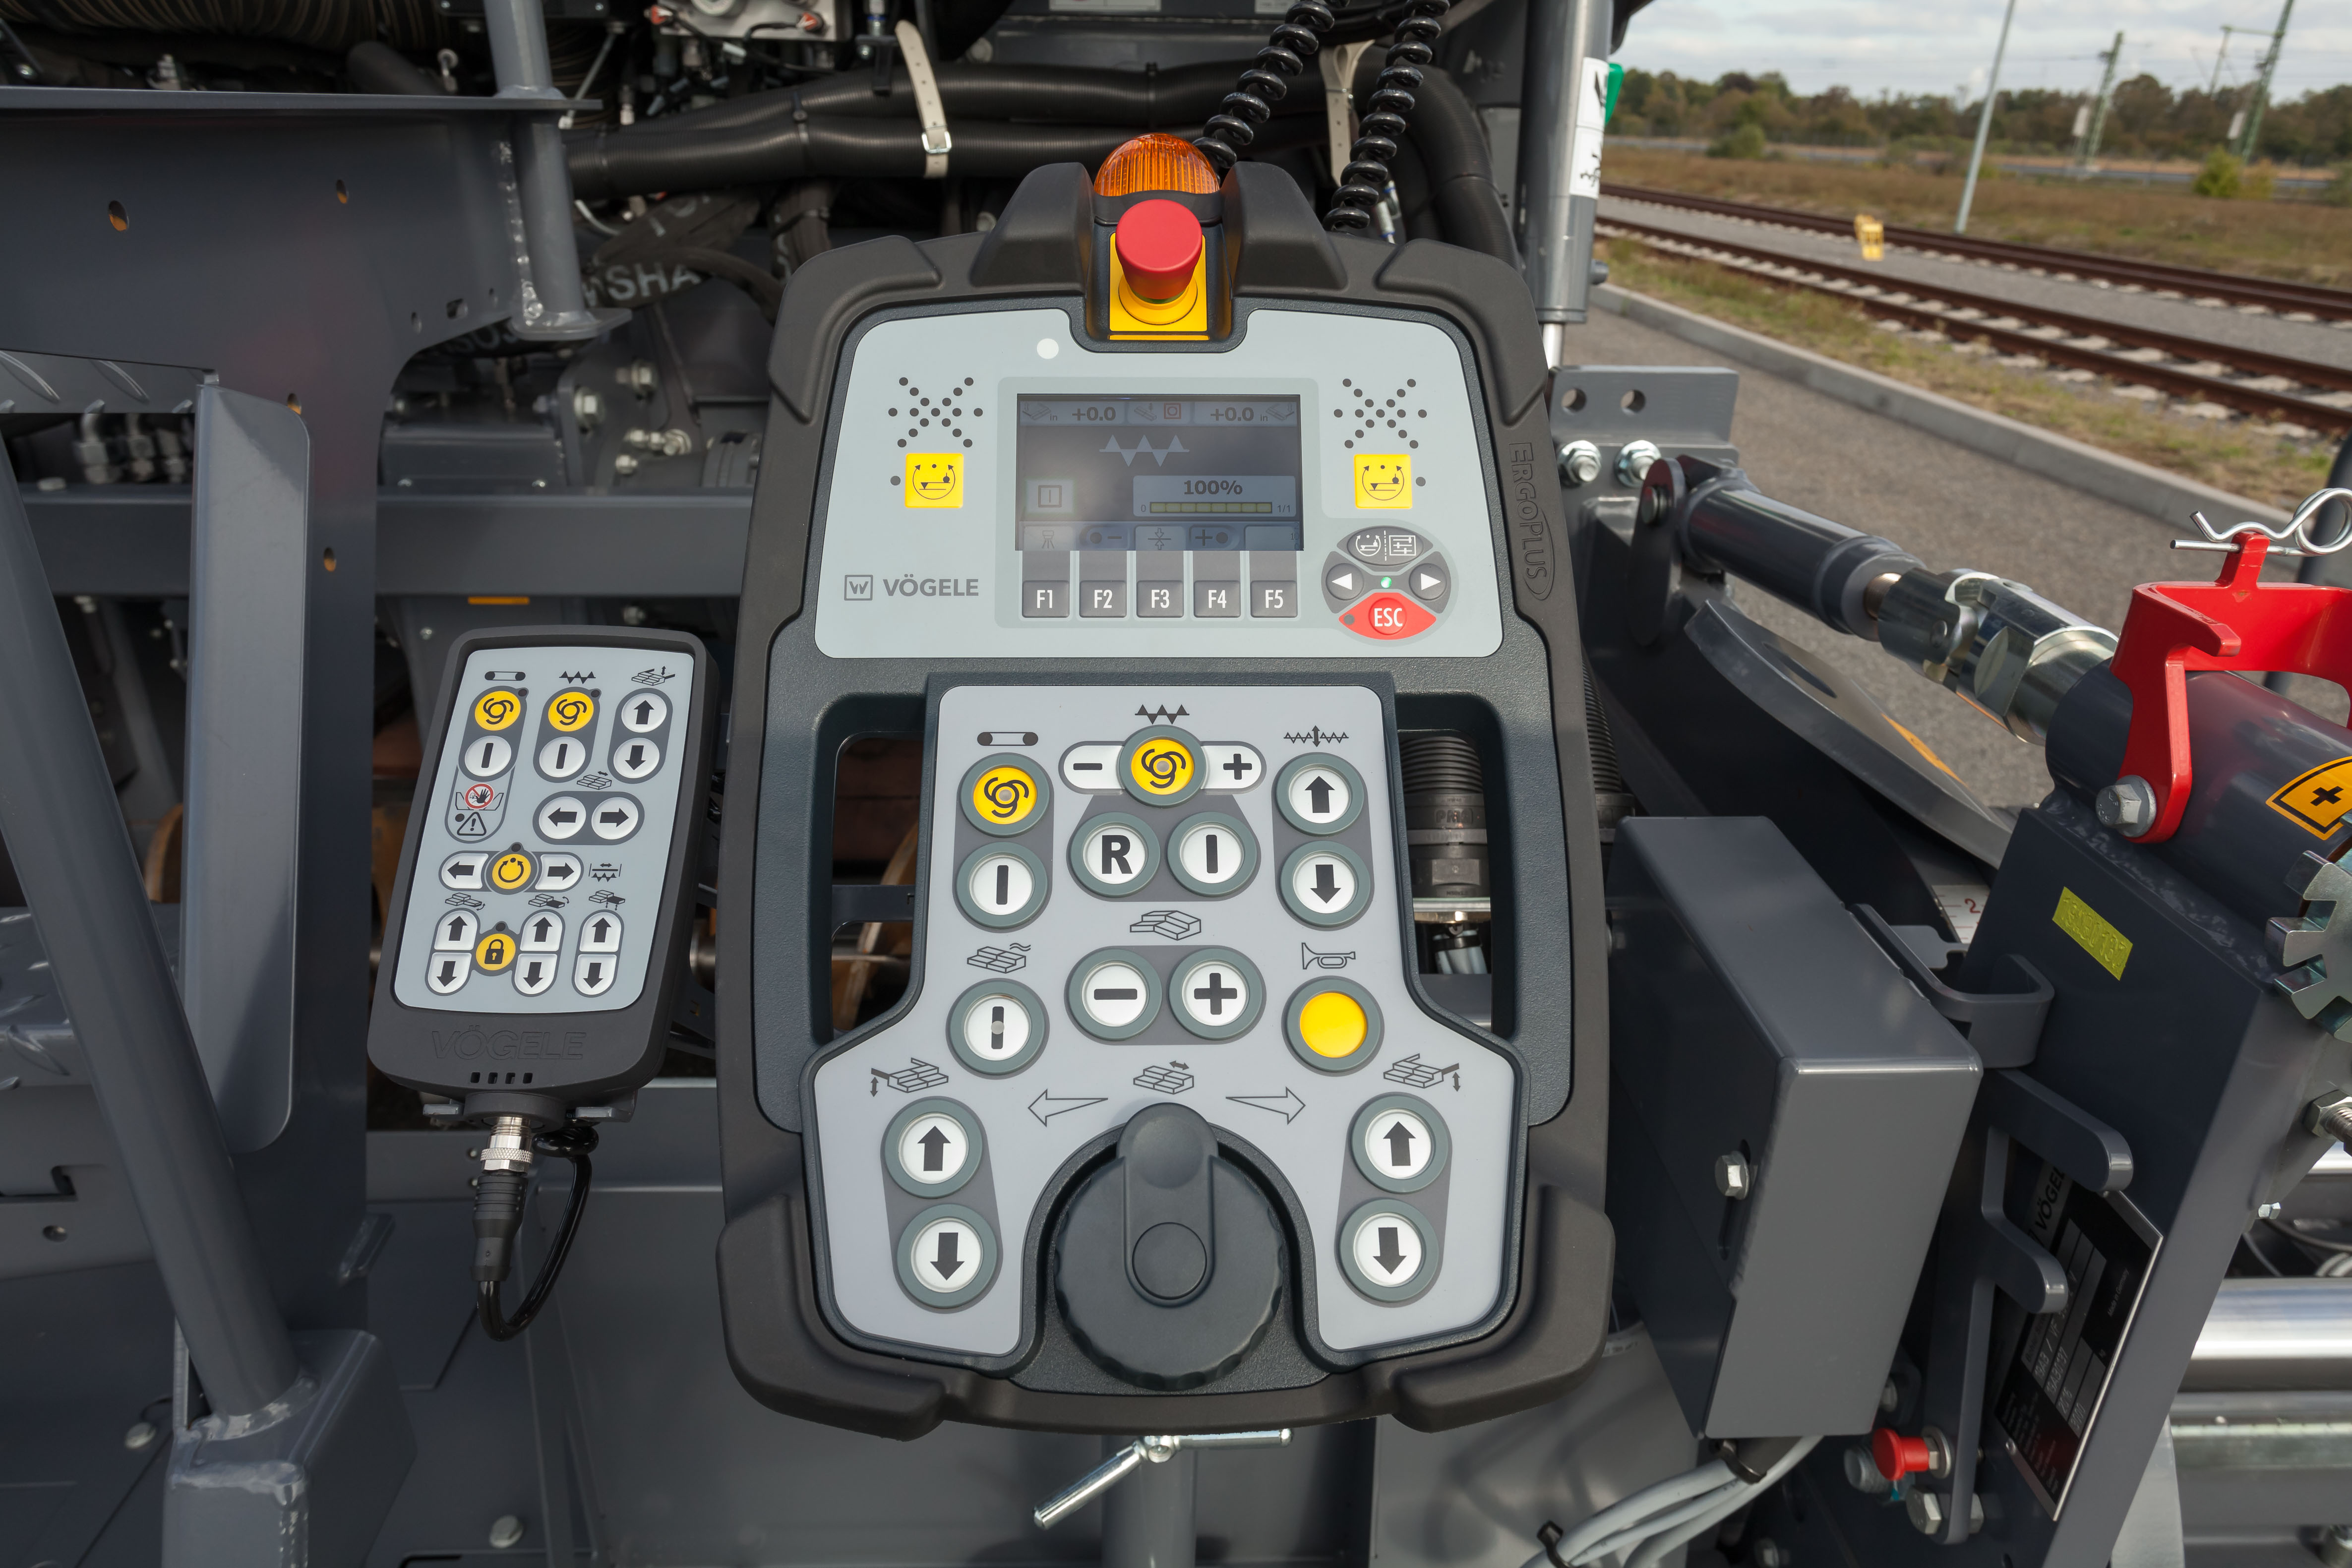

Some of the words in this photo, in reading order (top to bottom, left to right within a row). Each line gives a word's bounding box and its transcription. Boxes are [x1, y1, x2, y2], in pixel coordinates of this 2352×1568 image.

[1072, 406, 1116, 422] +0.0
[1210, 407, 1254, 422] +0.0
[1260, 414, 1268, 422] in
[1183, 480, 1243, 496] 100%
[1508, 442, 1547, 580] ERGOPLUS
[883, 573, 979, 597] VÖGELE
[1036, 589, 1054, 609] F1
[1094, 589, 1113, 609] F2
[1150, 589, 1170, 609] F3
[1208, 589, 1227, 609] F4
[1265, 589, 1284, 609] F5
[1374, 607, 1403, 627] ESC
[1101, 834, 1133, 874] R
[1964, 898, 1981, 913] 2
[431, 1024, 587, 1060] VÖGELE
[2035, 1164, 2065, 1232] VÖGEL
